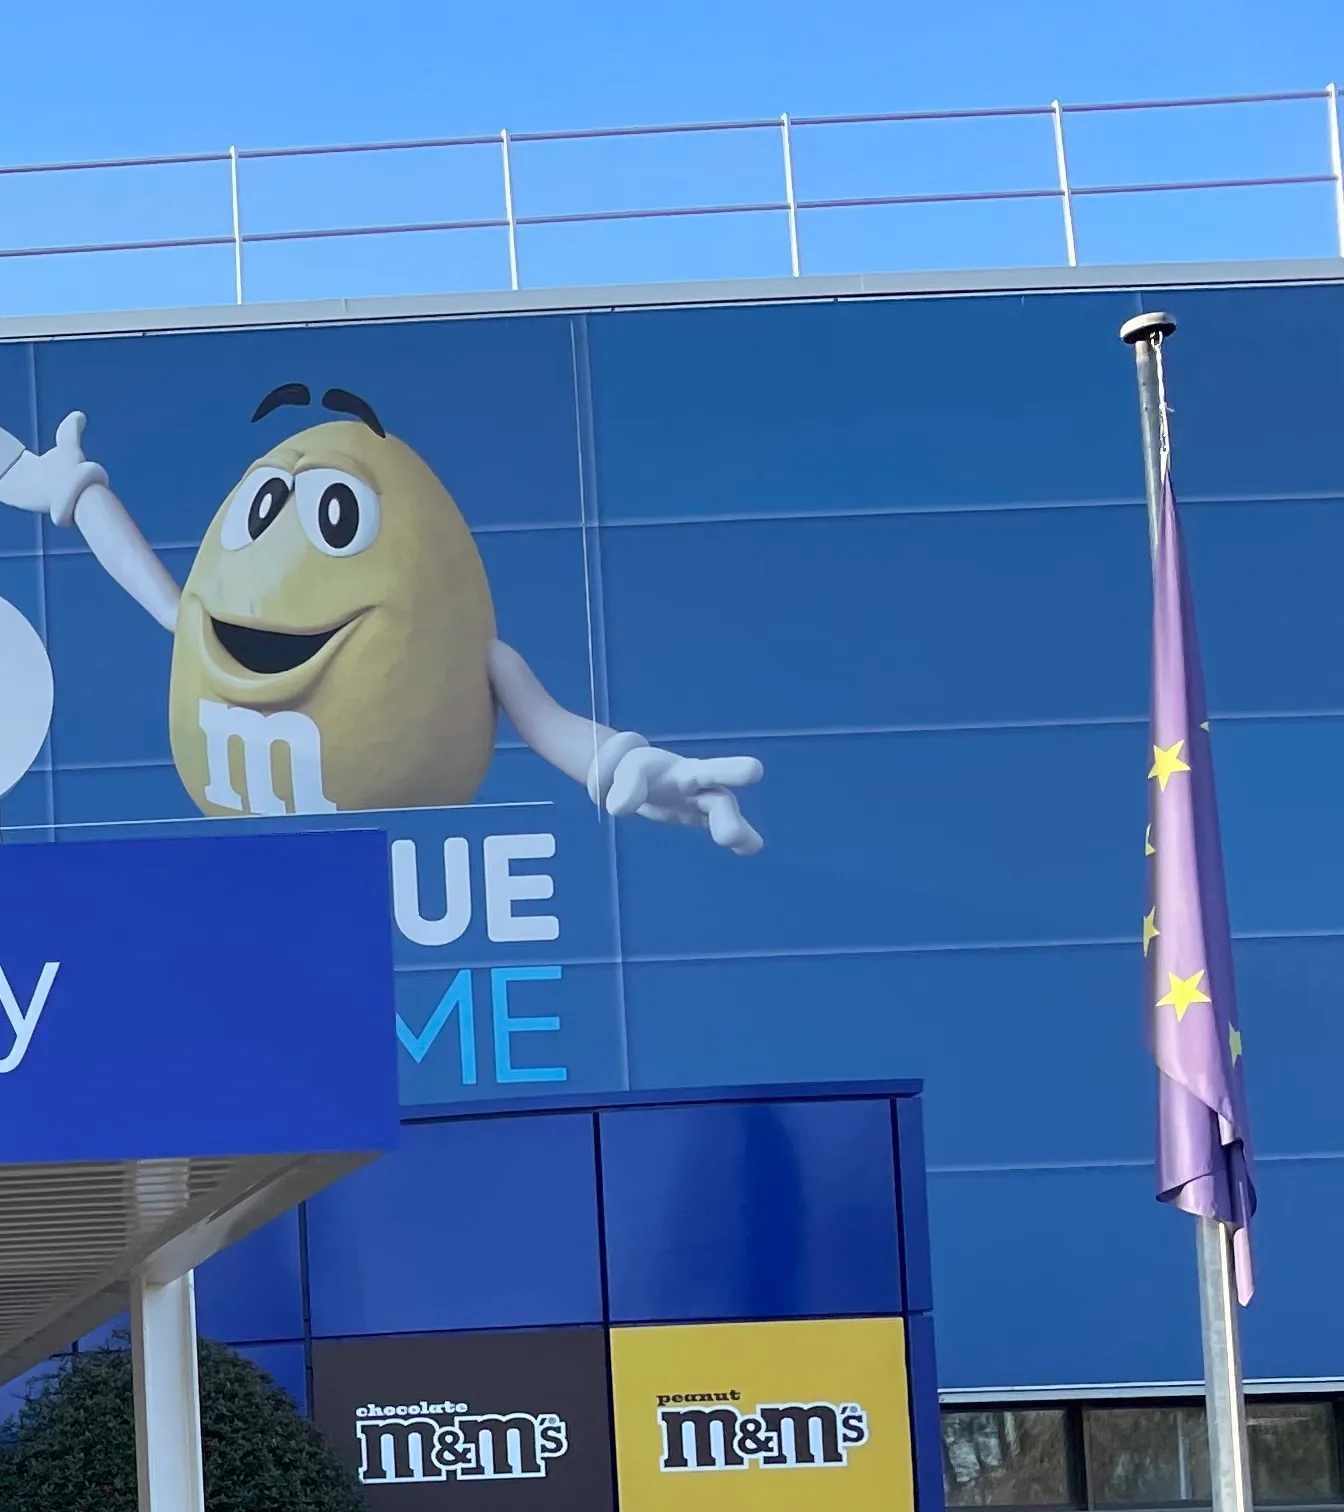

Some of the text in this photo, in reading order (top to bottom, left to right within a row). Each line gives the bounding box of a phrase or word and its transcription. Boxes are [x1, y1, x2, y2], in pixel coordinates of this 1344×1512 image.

[199, 699, 337, 815] m
[390, 833, 561, 947] UE
[355, 1400, 469, 1418] chocolate
[657, 1389, 742, 1407] peanut
